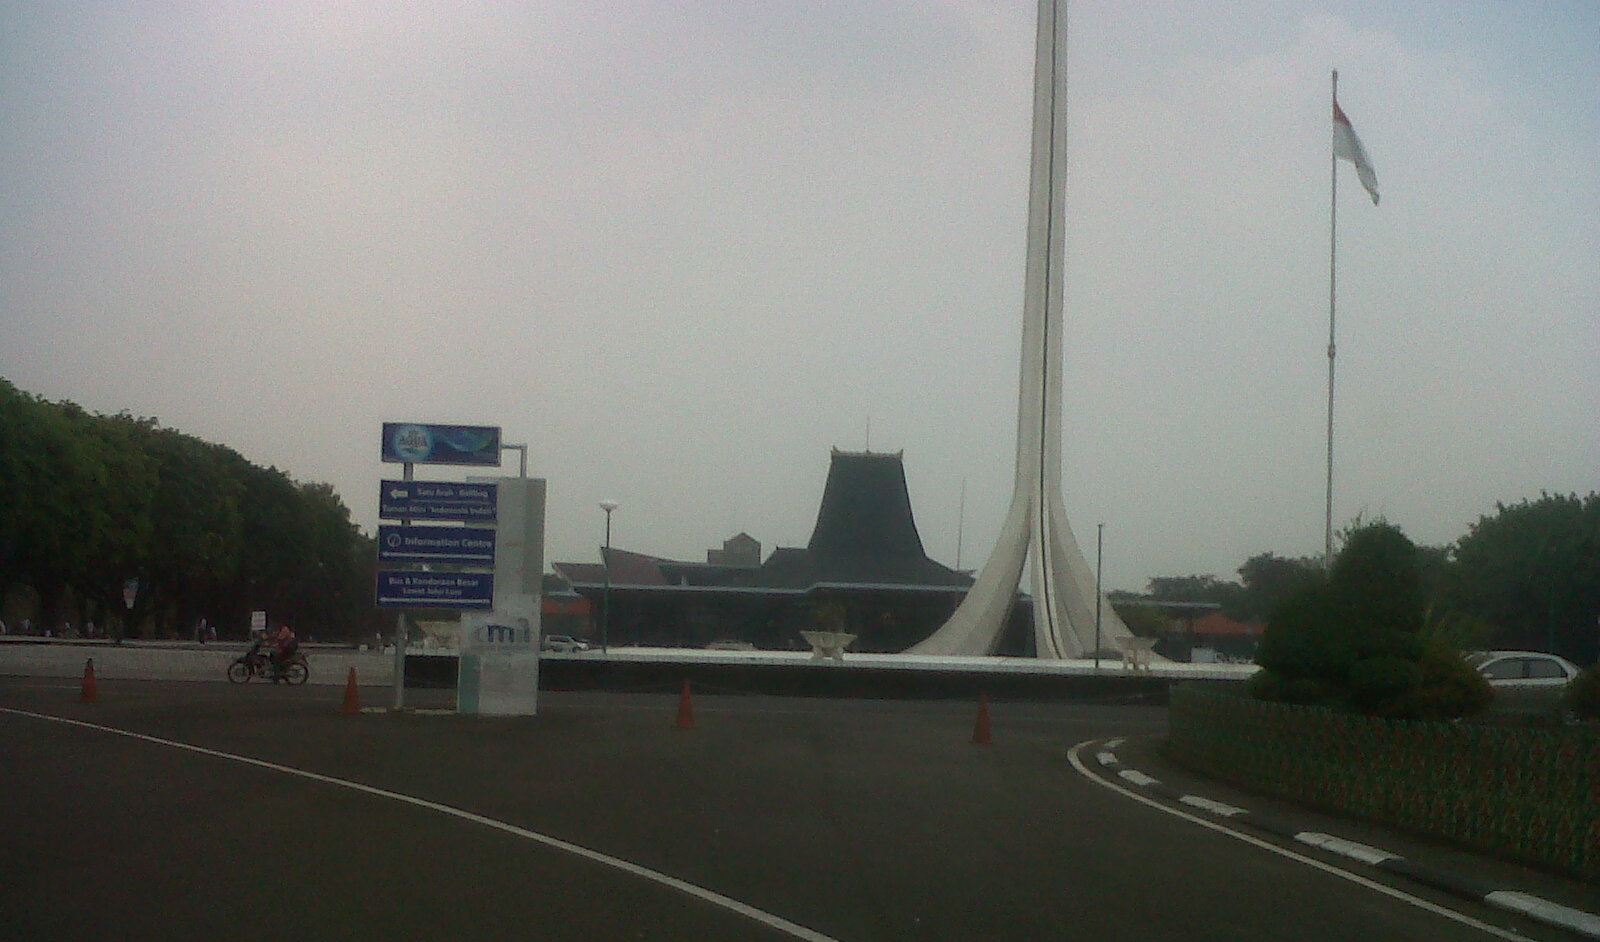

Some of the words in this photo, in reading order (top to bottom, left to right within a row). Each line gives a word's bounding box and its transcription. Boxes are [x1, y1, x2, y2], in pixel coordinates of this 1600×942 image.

[404, 537, 460, 546] Information
[462, 538, 492, 548] Centre
[388, 577, 404, 585] Bus
